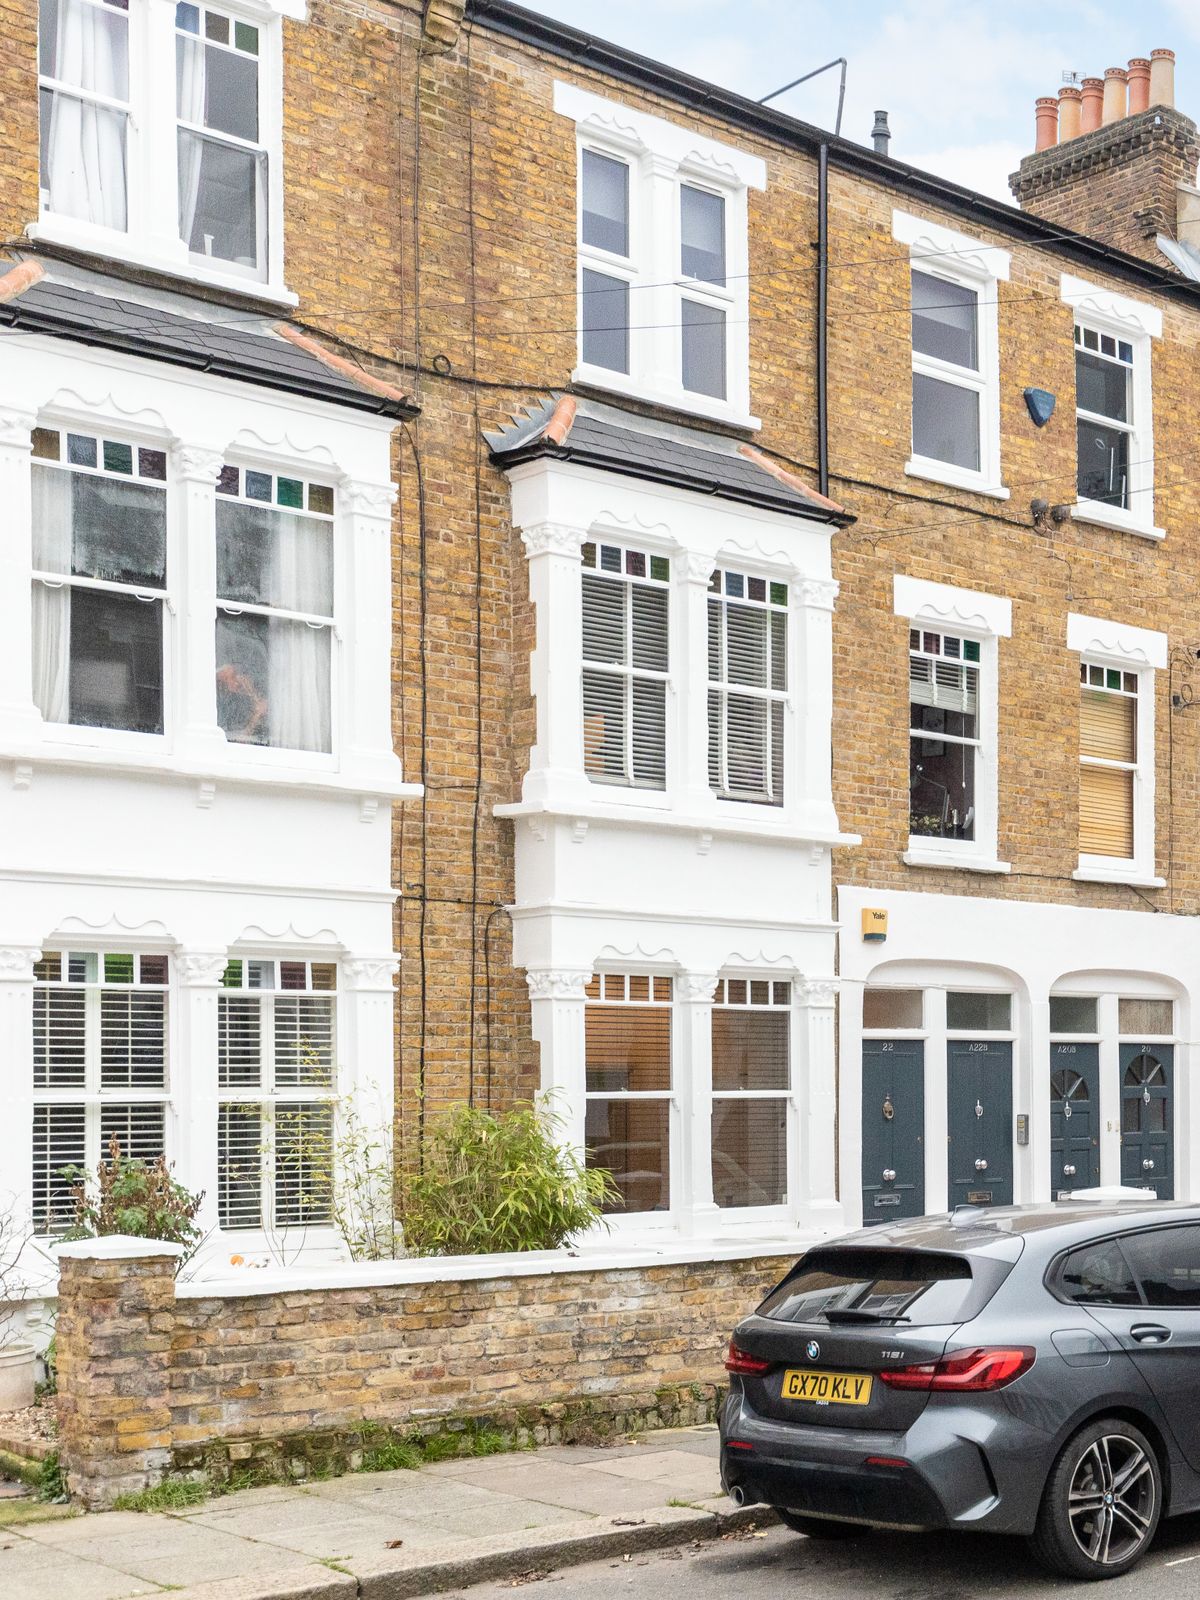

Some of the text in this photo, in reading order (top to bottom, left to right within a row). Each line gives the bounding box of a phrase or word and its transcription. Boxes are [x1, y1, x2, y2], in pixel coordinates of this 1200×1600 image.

[872, 911, 886, 920] Yale
[882, 1043, 894, 1052] 22
[1141, 1045, 1152, 1053] 20
[788, 1374, 865, 1400] GX70 KLV
